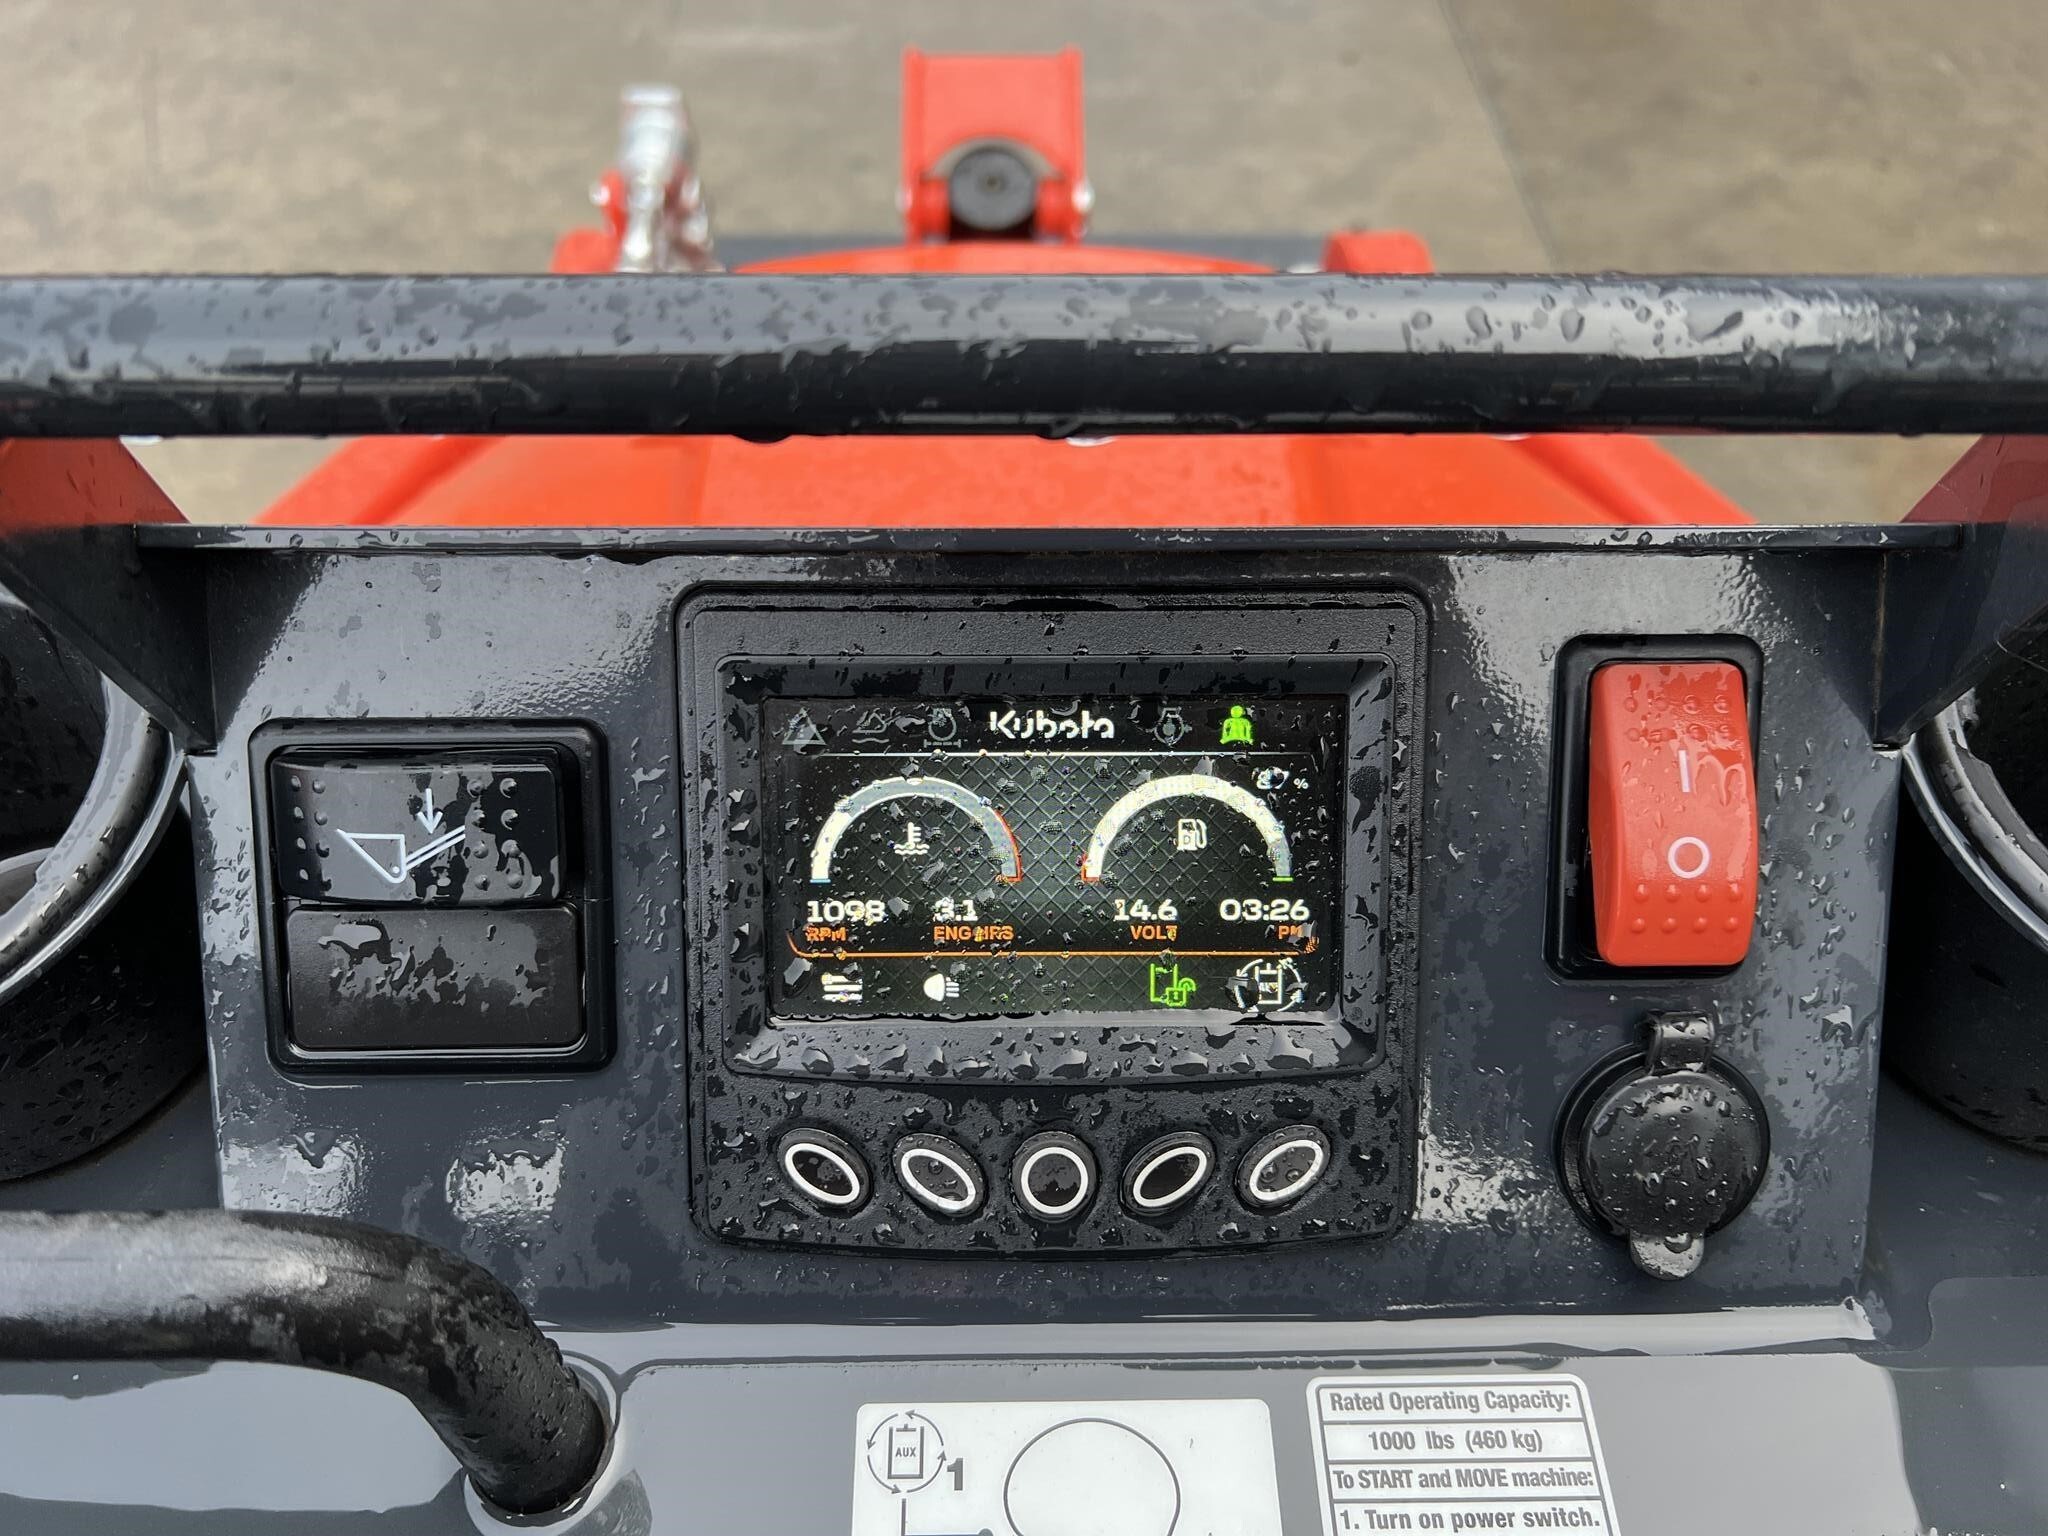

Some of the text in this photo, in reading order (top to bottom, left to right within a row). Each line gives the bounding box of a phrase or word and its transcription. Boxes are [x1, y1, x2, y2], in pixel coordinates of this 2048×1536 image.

[990, 710, 1114, 739] Kubota
[807, 900, 885, 922] 1098
[1114, 900, 1178, 921] 14.6
[1220, 899, 1310, 921] 03:26
[807, 926, 846, 941] RPM
[933, 926, 1014, 941] ENG HRS
[1130, 926, 1178, 941] VOLT
[1329, 1390, 1571, 1413] Rated Operating Capacity:
[895, 1446, 917, 1458] AUX
[1368, 1429, 1543, 1453] 1000 lbs (460 kg)
[947, 1458, 963, 1491] 1
[1333, 1467, 1594, 1489] To START and MOVE machine:
[1340, 1507, 1600, 1533] 1. Turn on power switch.
